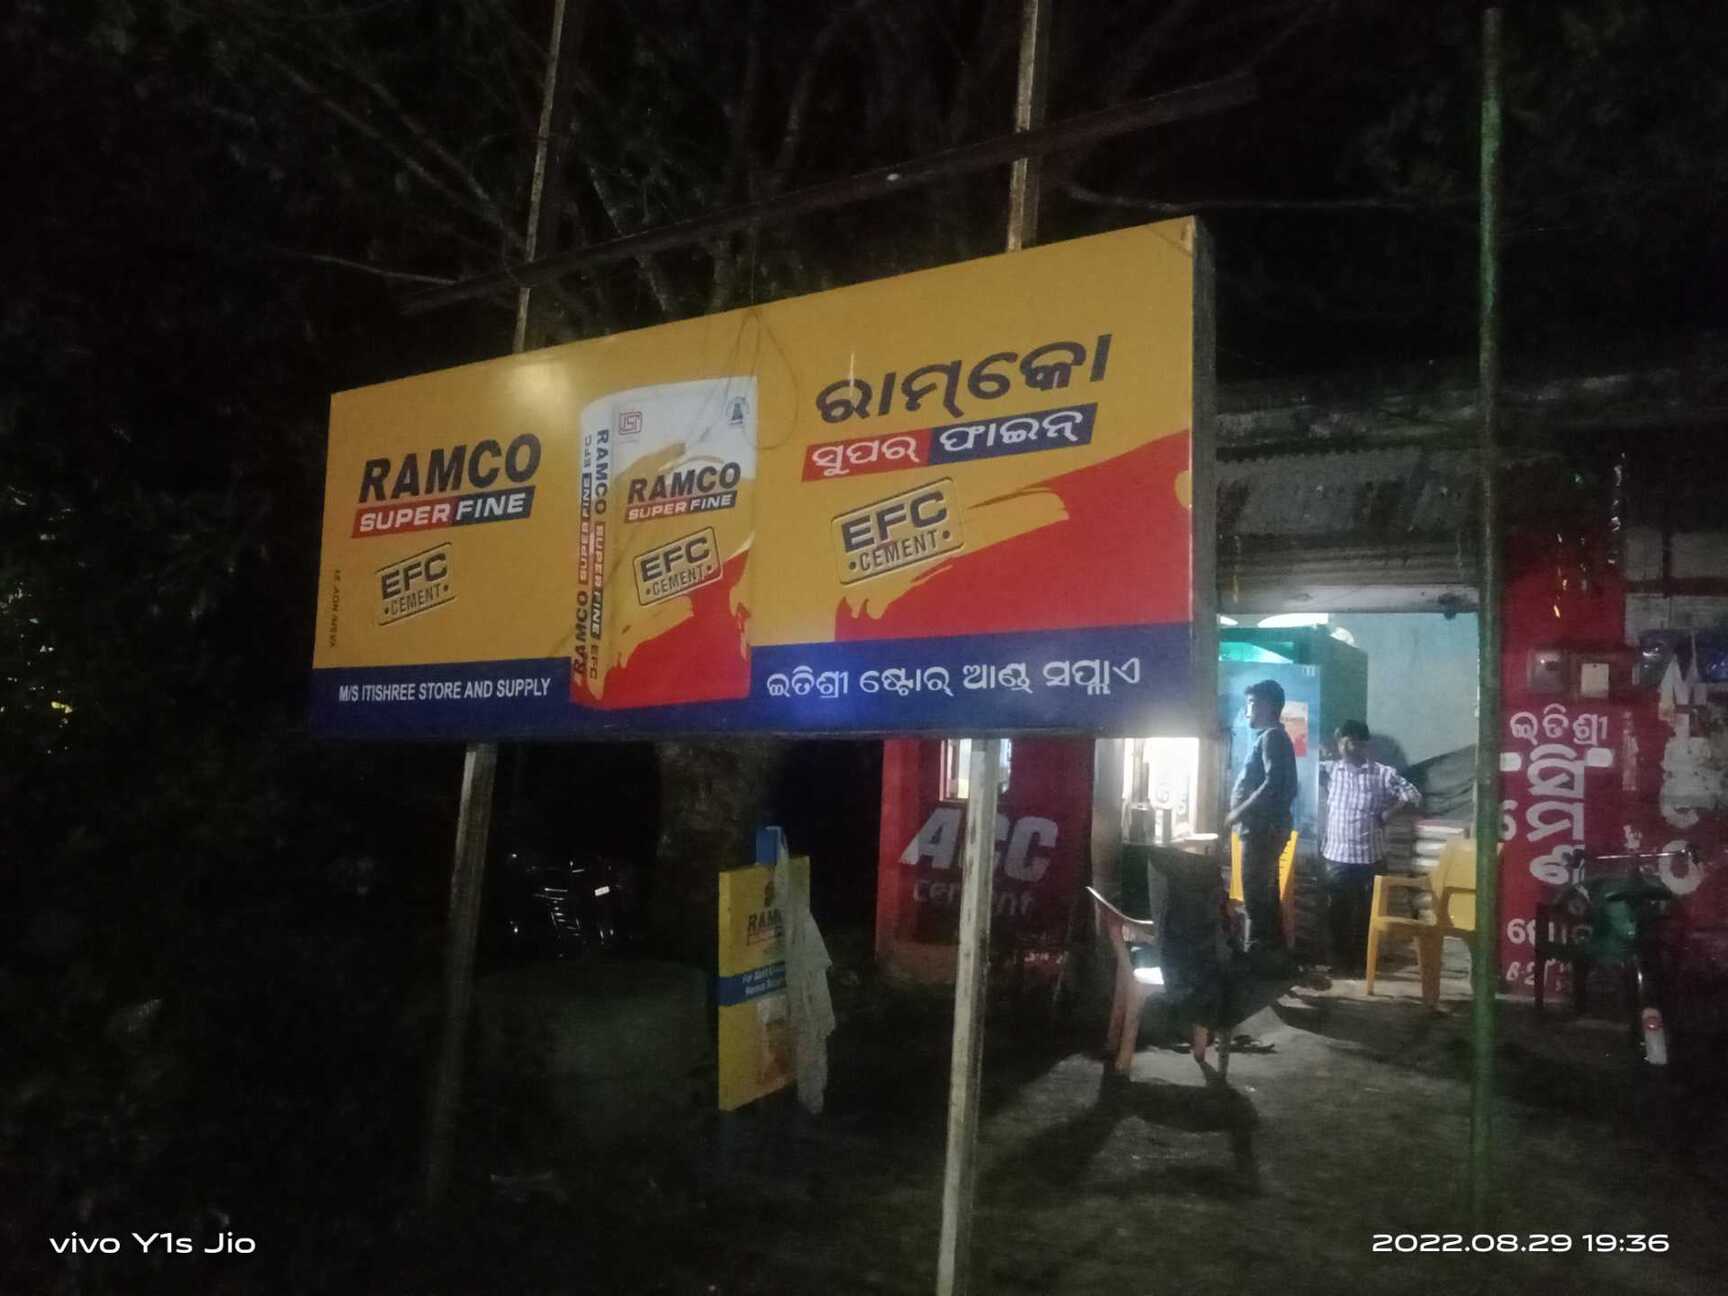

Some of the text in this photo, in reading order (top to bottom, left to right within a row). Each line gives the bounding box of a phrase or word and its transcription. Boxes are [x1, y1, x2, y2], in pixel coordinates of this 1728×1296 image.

[812, 410, 1082, 477] ସୁପର୍ ଫାଇନ୍
[358, 433, 542, 503] RAMCO
[595, 430, 609, 515] RAMCO
[627, 461, 742, 504] RAMCO
[359, 492, 527, 533] SUPER FINE
[628, 493, 734, 521] SUPER FINE
[842, 489, 948, 553] EFC
[579, 520, 589, 583] SUPER
[594, 524, 604, 588] SUPER
[641, 536, 711, 582] EFC
[859, 530, 939, 572] CEMENT
[381, 553, 447, 600] EFC
[390, 582, 441, 616] CEMENT
[652, 565, 705, 597] CEMENT
[574, 590, 588, 674] RAMCO
[591, 589, 602, 638] FINE
[361, 683, 416, 701] ITISHREE
[419, 681, 461, 700] STORE
[464, 680, 493, 699] AND
[496, 677, 551, 697] SUPPLY
[766, 665, 849, 698] ଇତିଶ୍ରୀ
